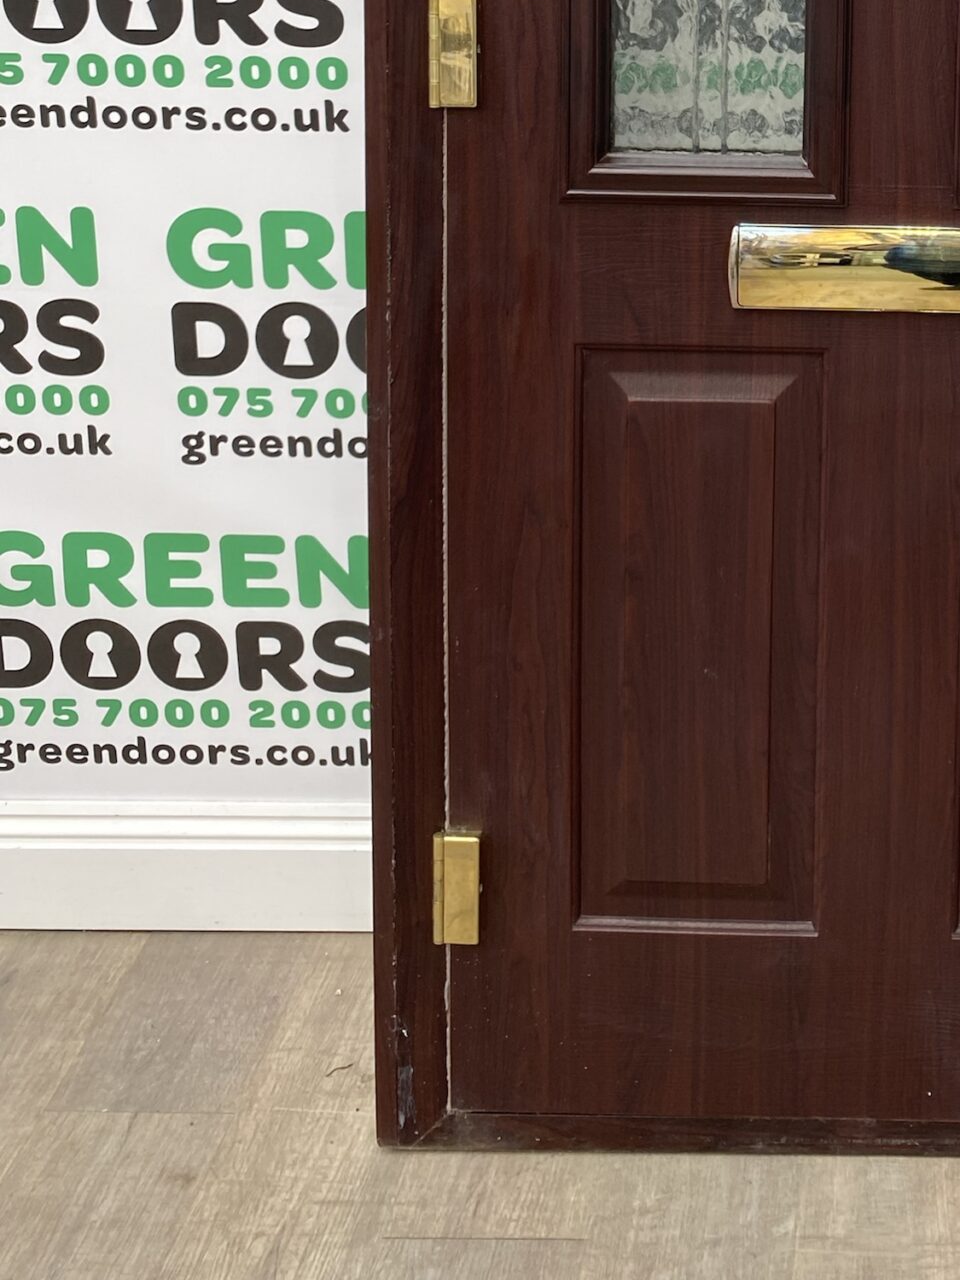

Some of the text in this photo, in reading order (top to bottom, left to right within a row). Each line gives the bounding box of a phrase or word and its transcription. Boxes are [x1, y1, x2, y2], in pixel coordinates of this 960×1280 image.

[42, 52, 185, 88] 7000
[204, 54, 349, 91] 2000
[0, 96, 349, 133] endoors.co.uk
[171, 302, 367, 380] DO
[4, 384, 111, 416] 000
[177, 385, 368, 420] 075 70
[0, 530, 369, 609] GREEN
[0, 618, 371, 693] DOORS
[96, 698, 230, 728] 7000
